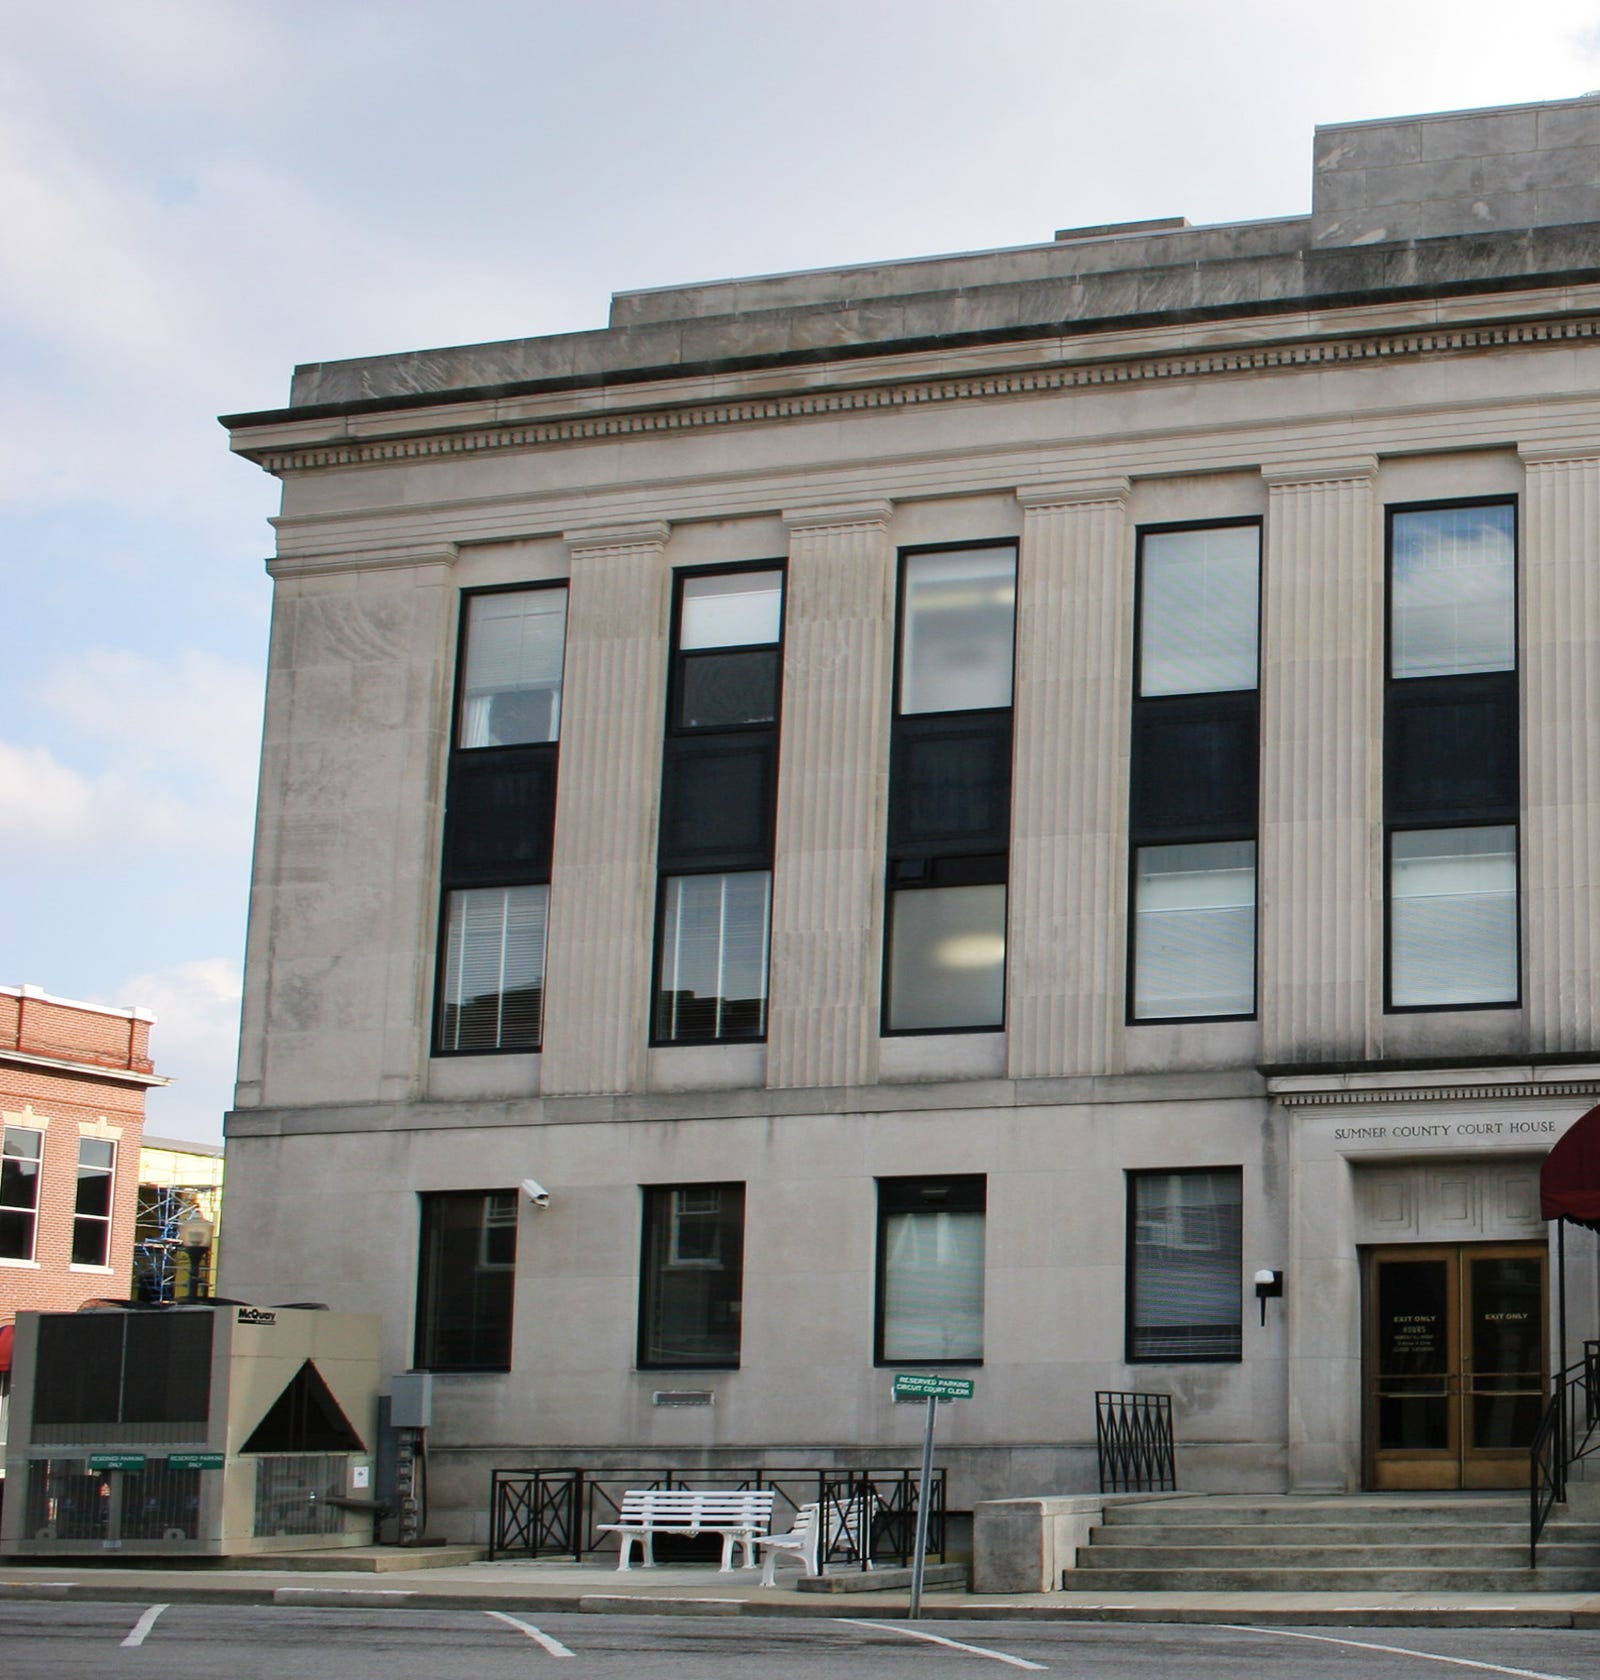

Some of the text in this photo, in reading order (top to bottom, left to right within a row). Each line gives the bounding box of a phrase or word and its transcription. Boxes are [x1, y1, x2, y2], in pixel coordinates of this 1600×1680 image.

[1334, 1121, 1556, 1140] SUMNER COUNTY COURT HOUSE
[238, 1308, 276, 1320] McQuay
[899, 1377, 969, 1388] RESERVED PARKING
